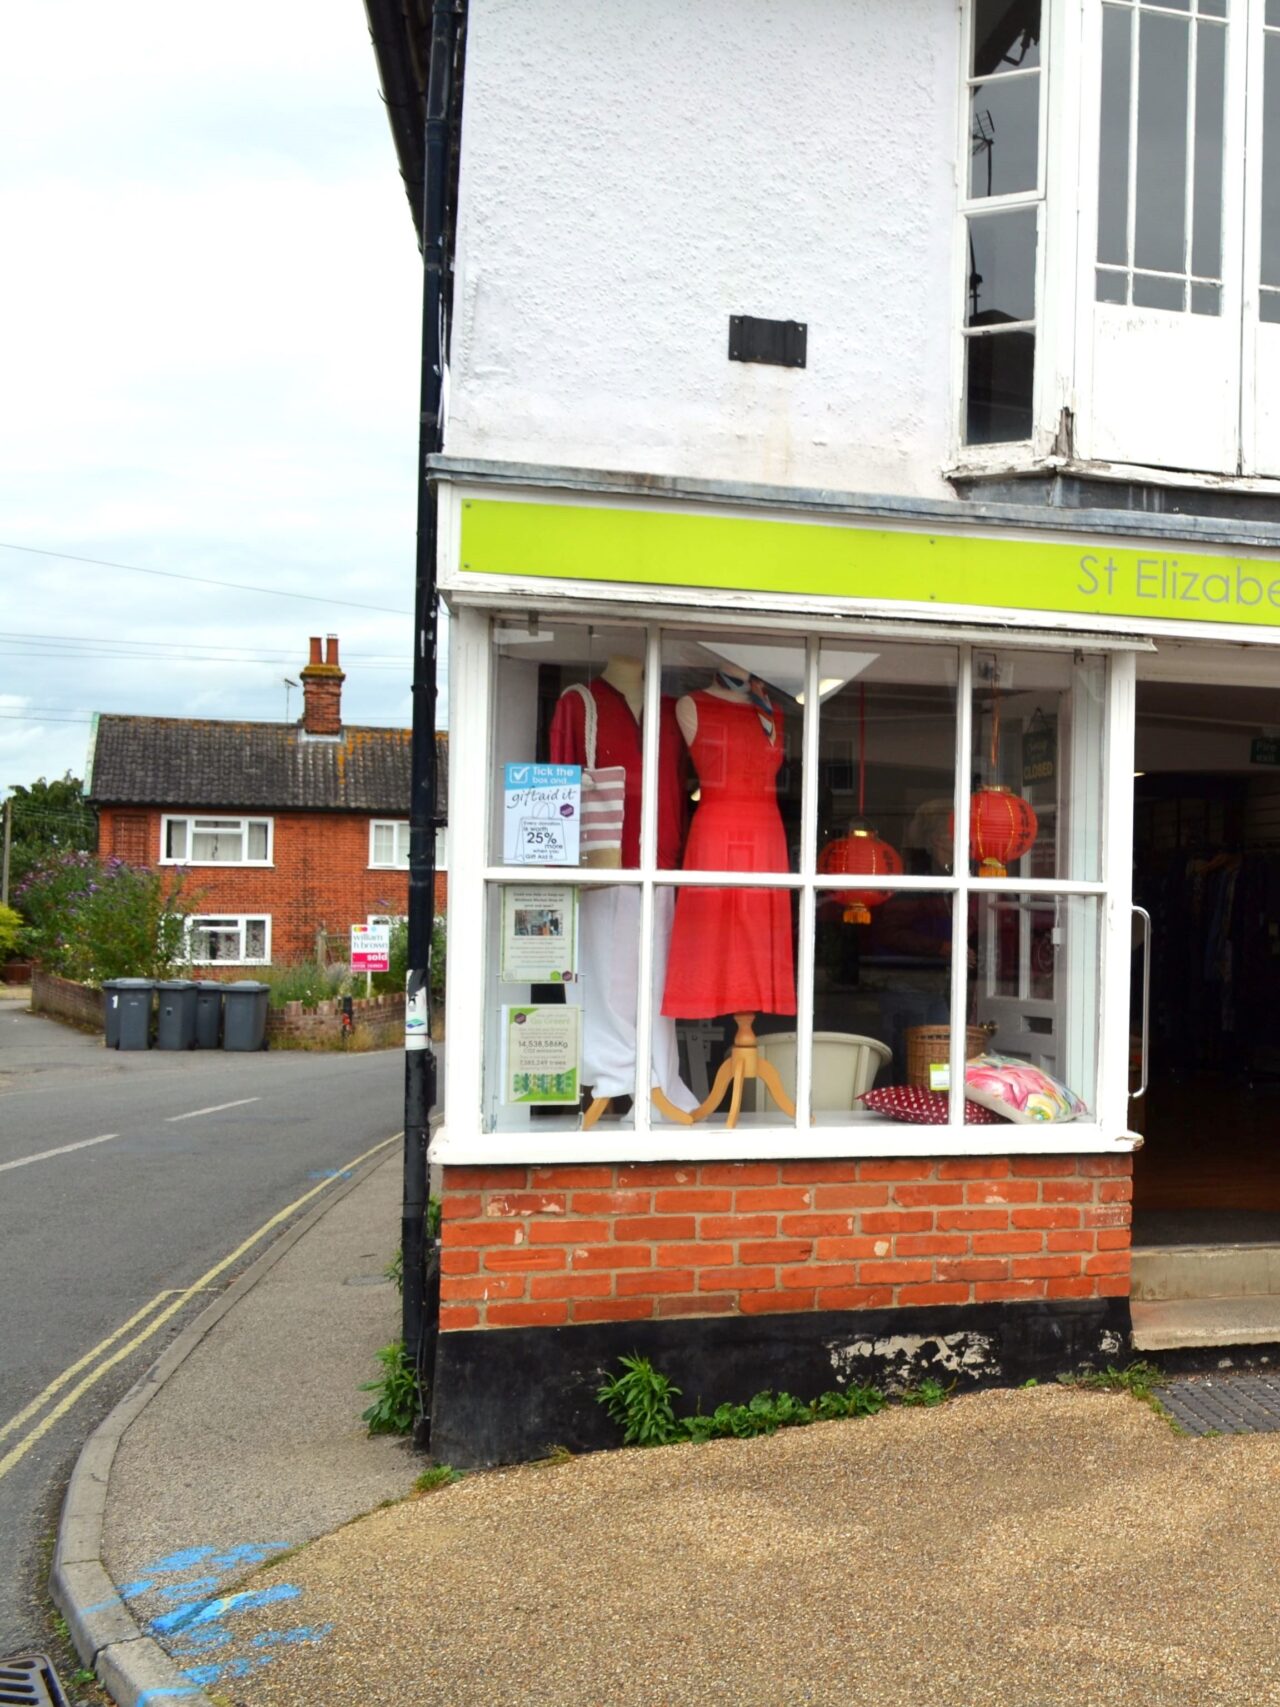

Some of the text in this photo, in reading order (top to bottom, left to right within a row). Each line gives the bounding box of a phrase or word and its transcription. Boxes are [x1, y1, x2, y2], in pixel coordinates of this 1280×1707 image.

[1077, 555, 1118, 595] St
[533, 766, 574, 777] Tick the
[1024, 761, 1053, 779] CLOSED
[551, 777, 567, 785] and
[562, 787, 577, 801] it
[527, 832, 557, 844] 25%
[353, 933, 383, 942] william
[353, 941, 388, 949] h brown
[367, 953, 388, 961] sold
[111, 994, 119, 1009] 1
